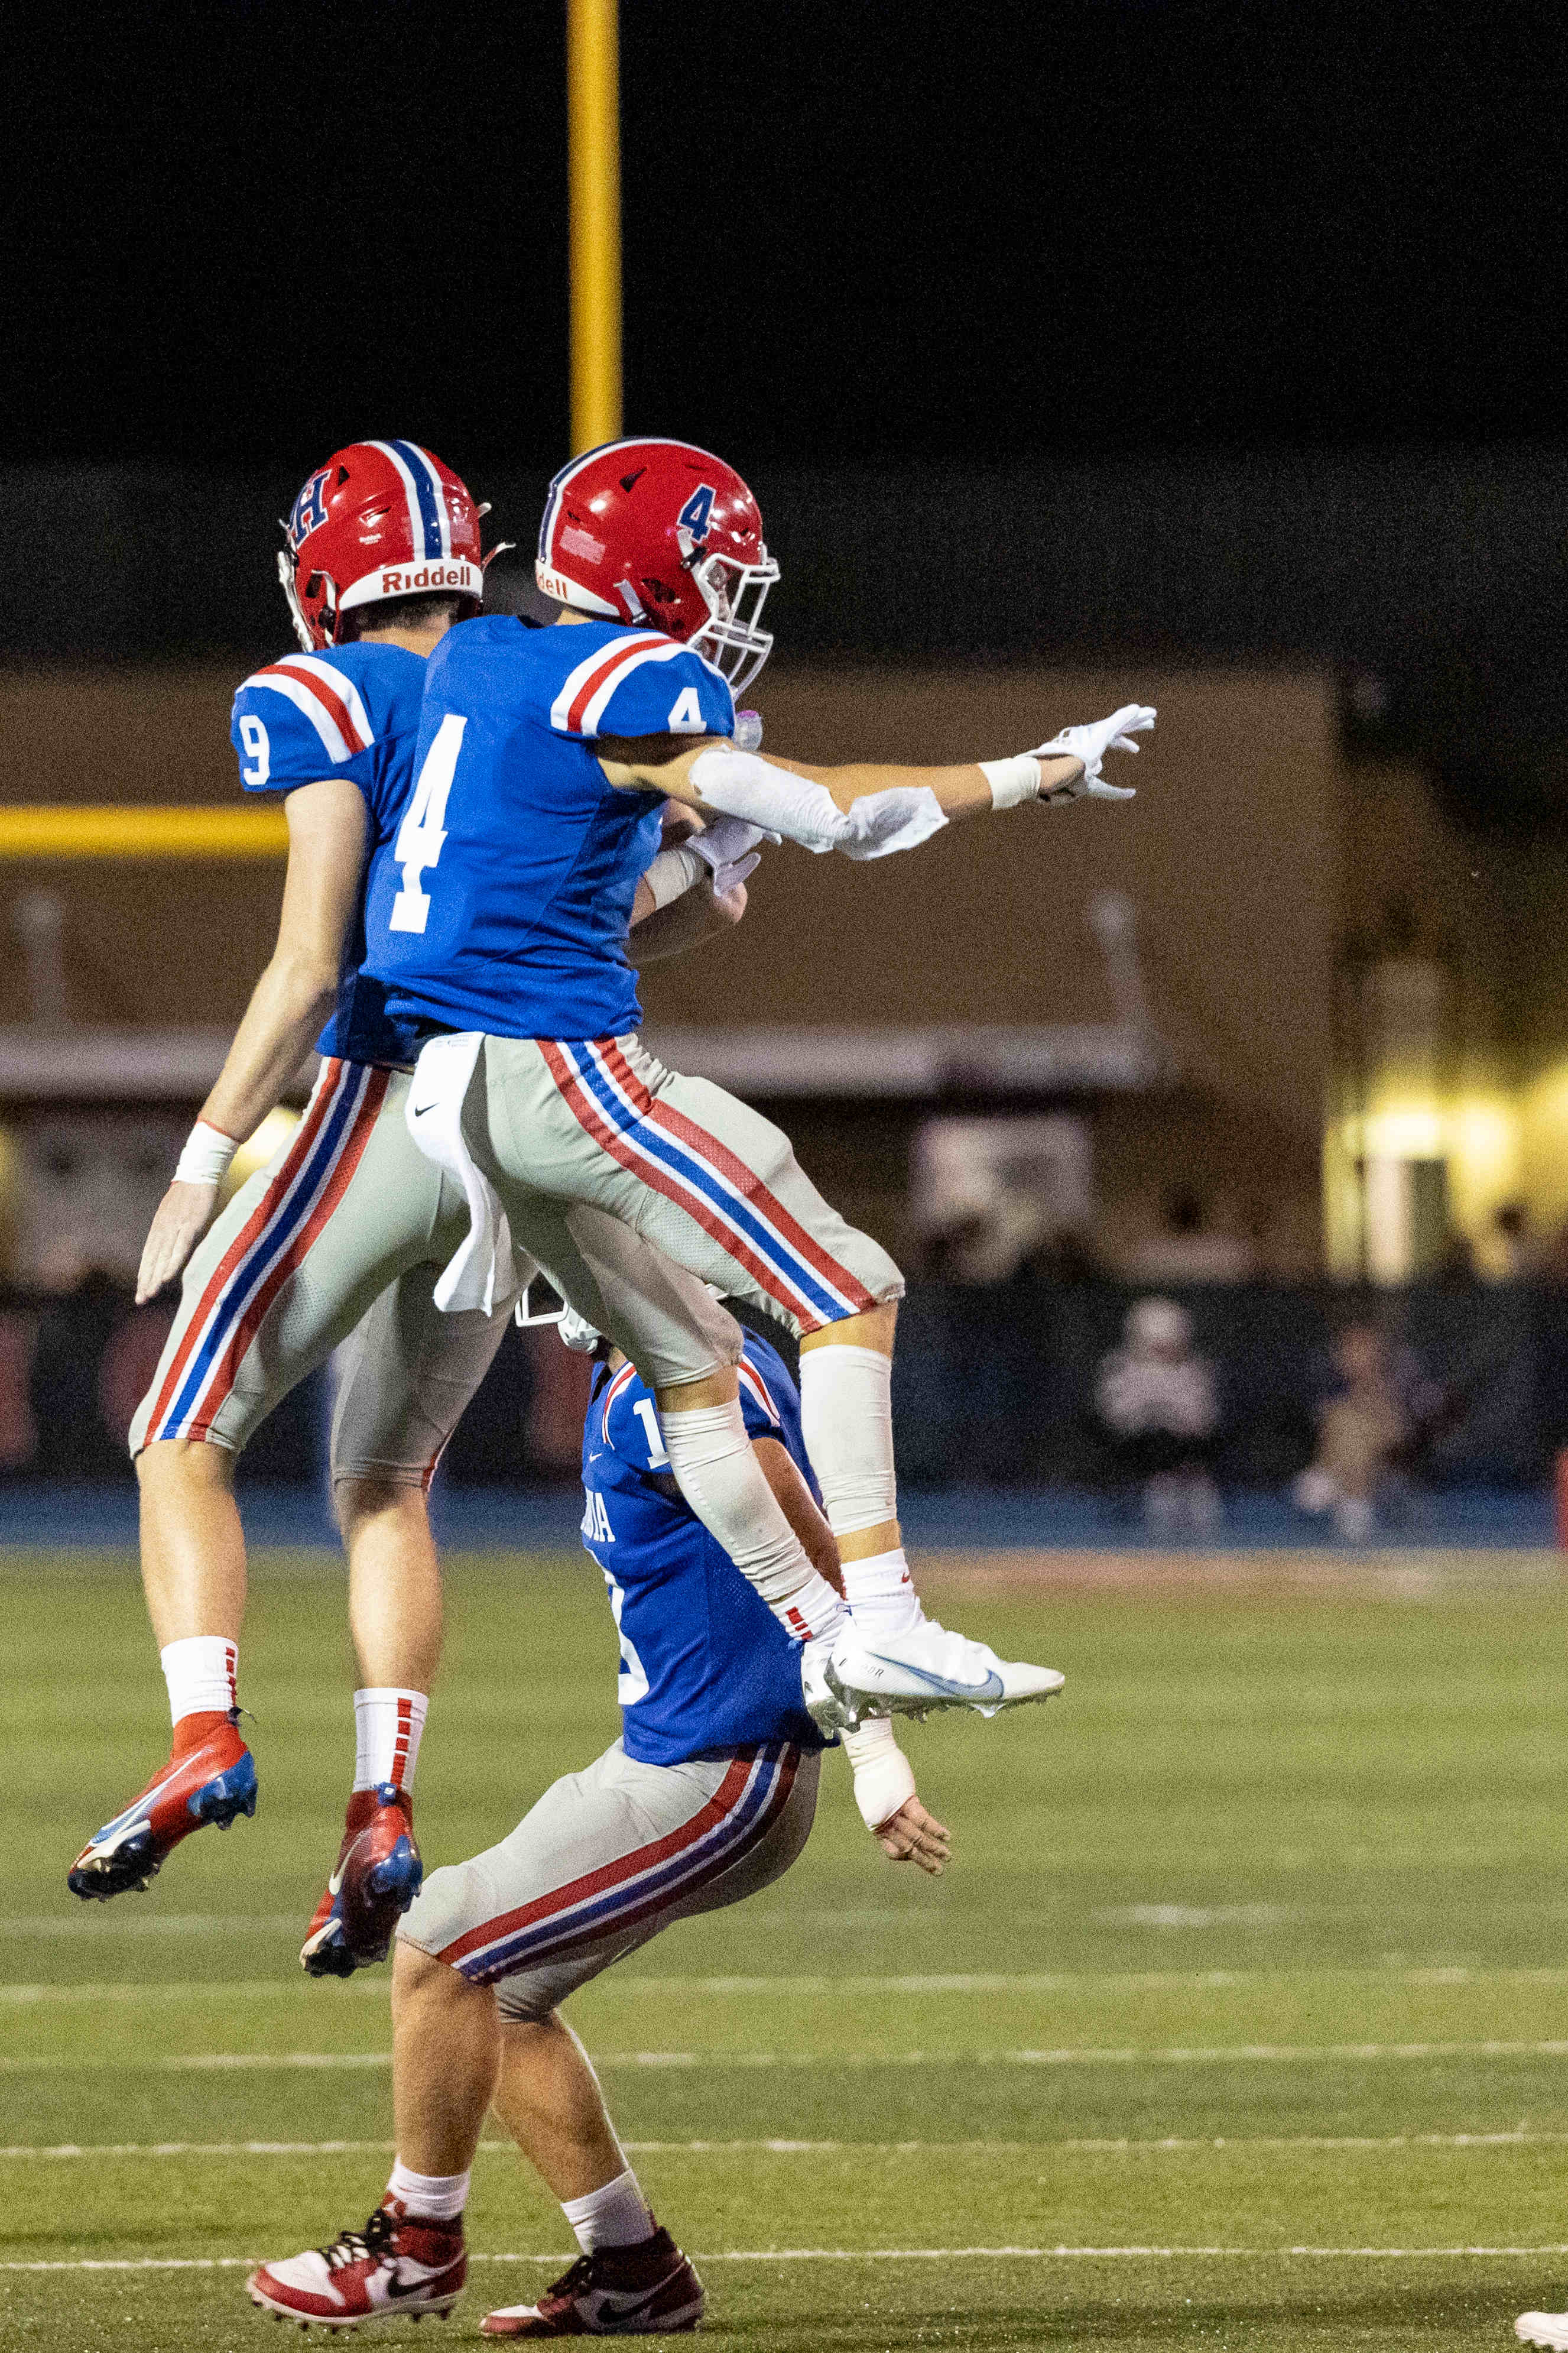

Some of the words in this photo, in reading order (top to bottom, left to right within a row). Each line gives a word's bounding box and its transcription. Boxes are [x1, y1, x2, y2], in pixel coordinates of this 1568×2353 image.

[289, 469, 332, 552] H
[676, 483, 716, 544] 4
[382, 566, 470, 593] Riddell
[667, 687, 707, 733] 4
[239, 715, 271, 785] 9
[389, 714, 468, 934] 4
[633, 1398, 670, 1469] 1
